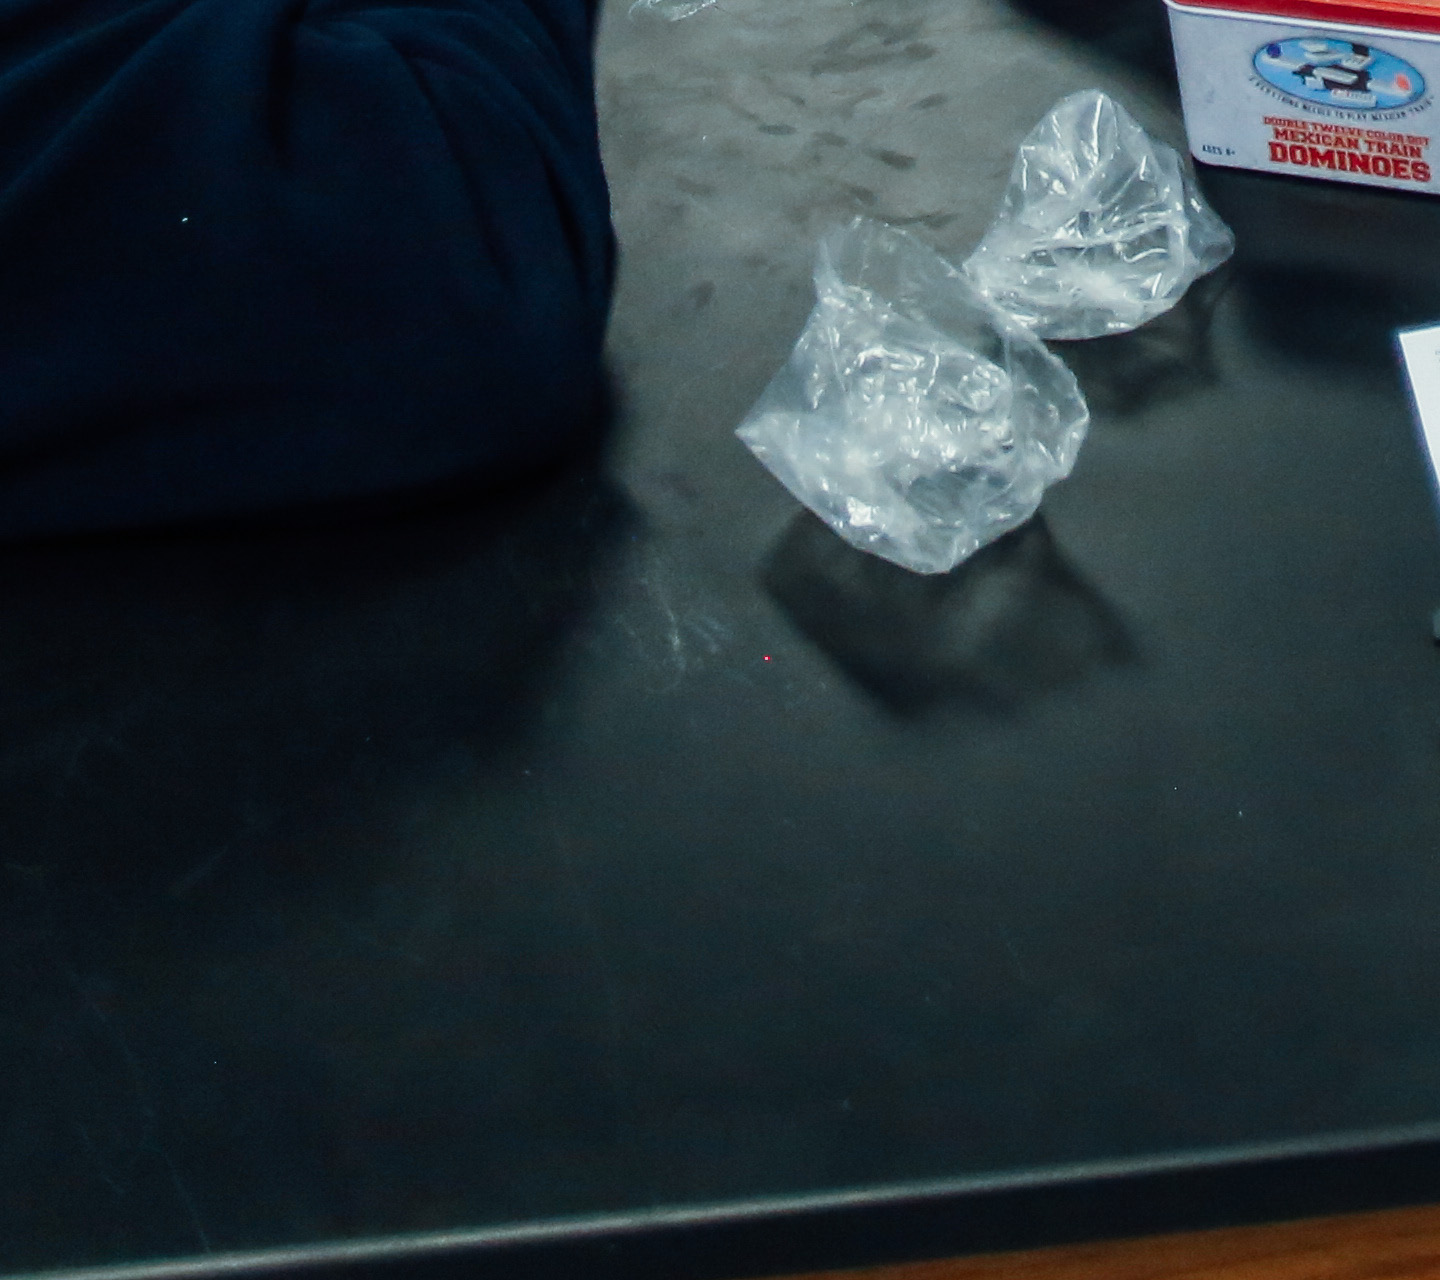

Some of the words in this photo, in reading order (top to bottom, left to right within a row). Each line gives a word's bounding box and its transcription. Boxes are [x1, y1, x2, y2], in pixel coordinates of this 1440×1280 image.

[1272, 127, 1360, 150] MEXICAN
[1363, 139, 1423, 159] TRAIN
[1311, 121, 1363, 137] TWELVE
[1268, 141, 1432, 183] DOMINOES
